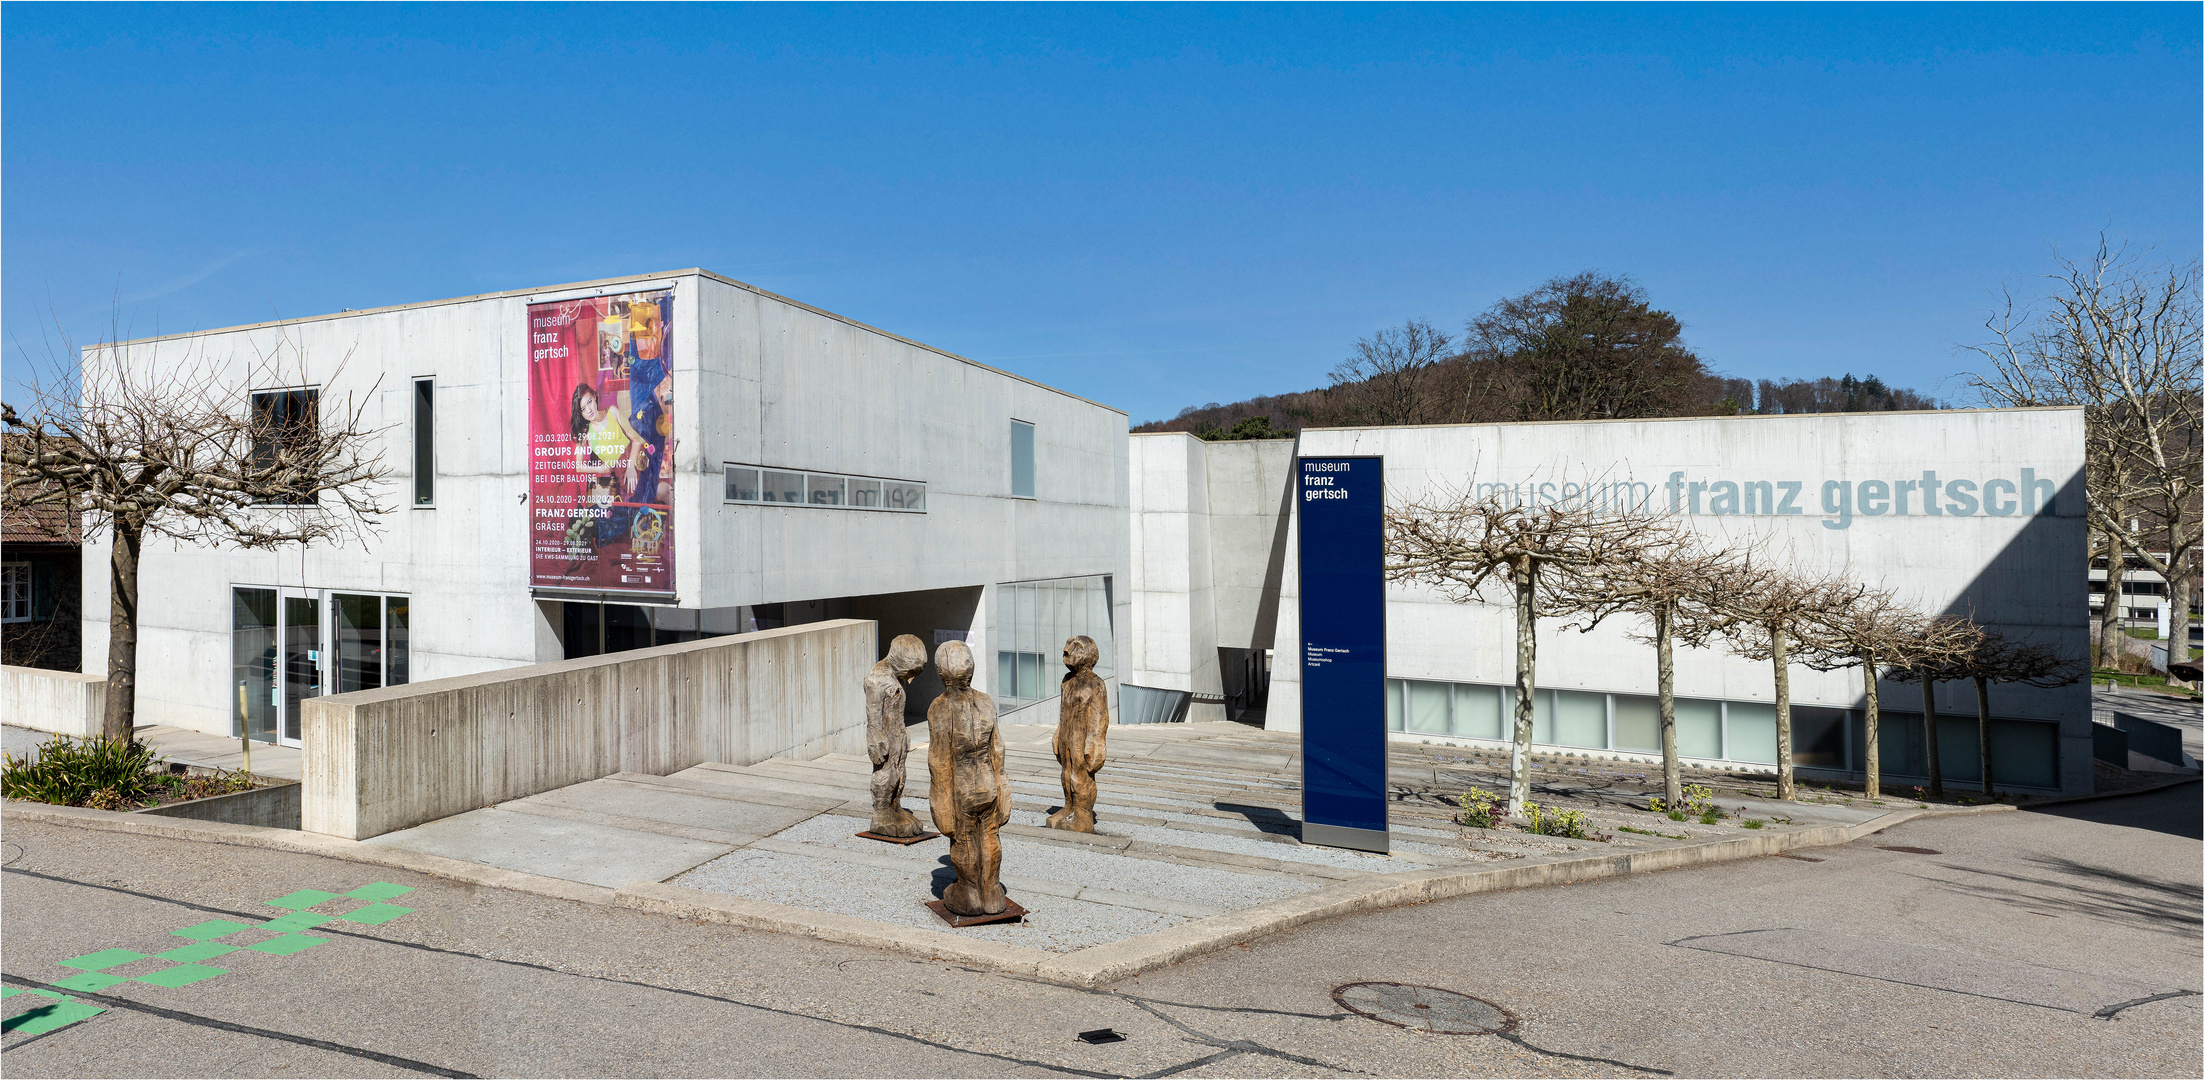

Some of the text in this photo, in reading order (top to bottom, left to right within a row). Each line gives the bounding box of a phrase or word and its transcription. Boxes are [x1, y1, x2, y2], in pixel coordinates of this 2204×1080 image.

[533, 314, 571, 328] museum
[533, 331, 558, 344] franz
[534, 345, 569, 362] gertsch
[534, 433, 572, 443] 20.03.2021
[577, 431, 616, 442] 29.08.2021
[534, 444, 625, 457] GROUPS AND SPOTS
[534, 459, 632, 470] ZEITGENÖSSISCHE KUNST
[1305, 462, 1350, 472] museum
[535, 473, 597, 483] BEI DER BALOISE
[1304, 474, 1335, 486] franz
[535, 494, 573, 504] 24.10.2020
[577, 494, 615, 504] 29.08.2021
[1305, 488, 1348, 502] gertsch
[1475, 467, 2056, 530] museum franz gertsch
[535, 508, 608, 518] FRANZ GERTSCH
[535, 520, 566, 531] GRÄSER
